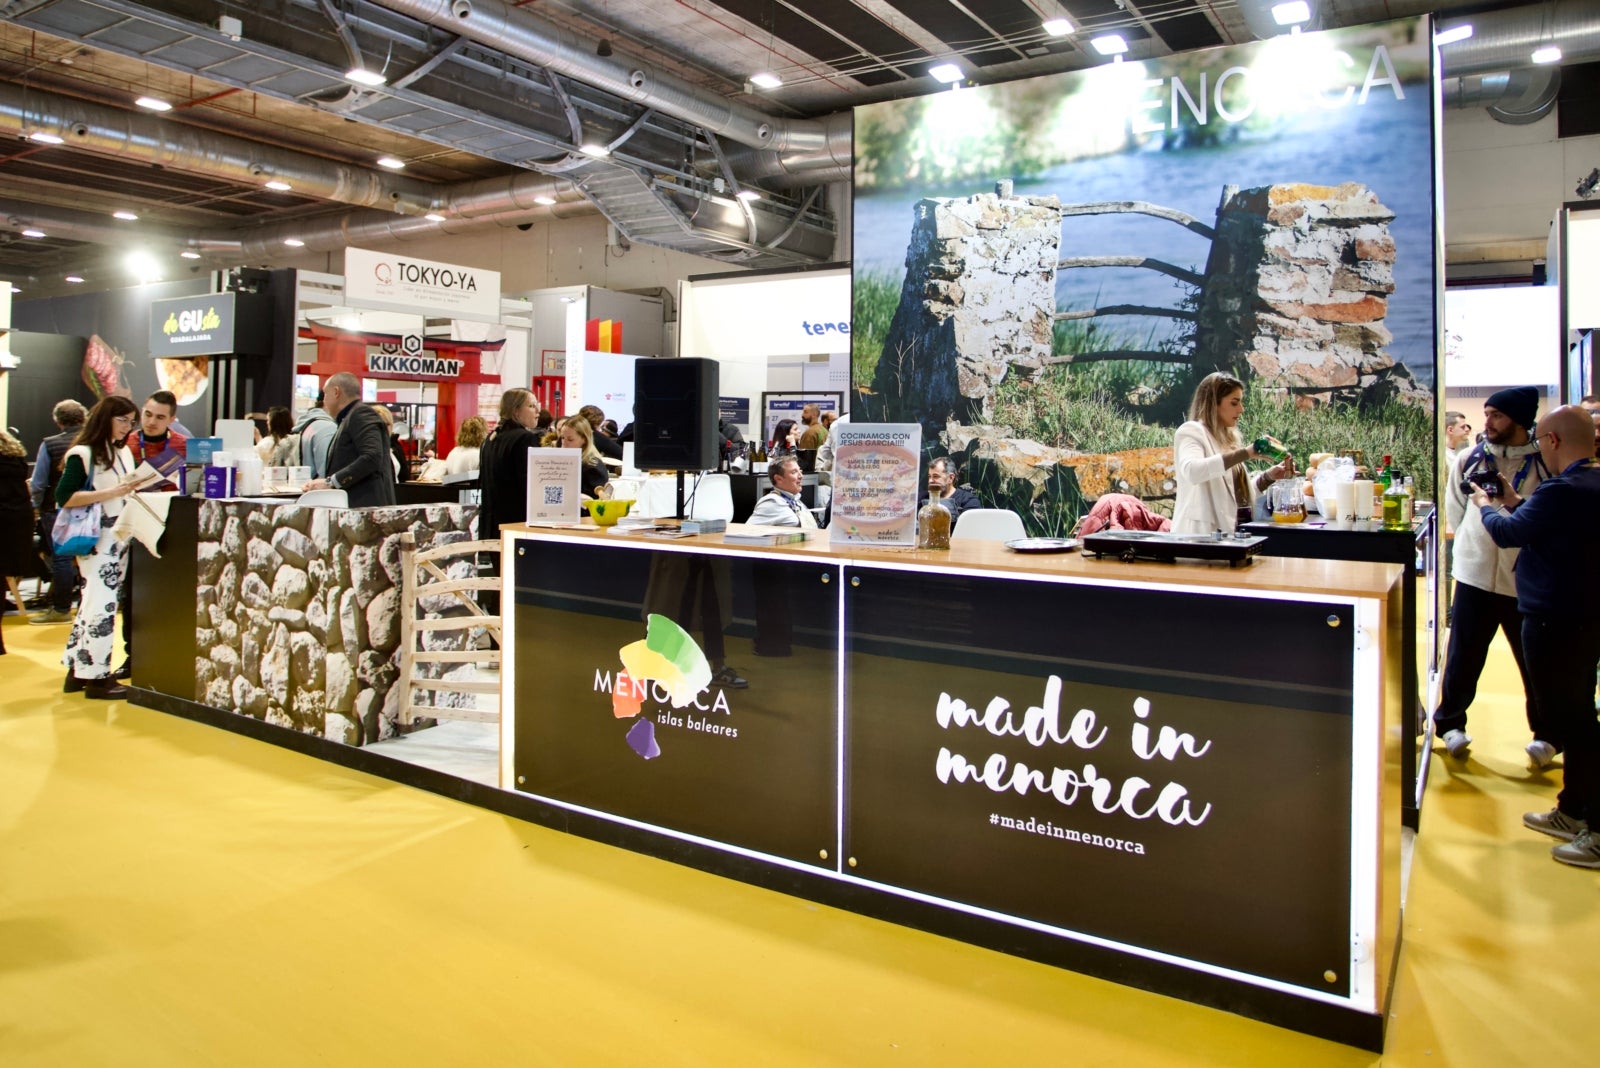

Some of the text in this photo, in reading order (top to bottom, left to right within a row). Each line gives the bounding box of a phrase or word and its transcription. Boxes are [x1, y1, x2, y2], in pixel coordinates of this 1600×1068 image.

[1095, 45, 1405, 137] ENOCA
[398, 262, 477, 291] TOKYO-YA
[802, 320, 850, 336] tene
[370, 355, 460, 375] KIKKOMAN
[593, 668, 731, 715] MENOCA
[657, 710, 738, 738] islas baleares
[936, 674, 1212, 761] made in
[936, 747, 1212, 826] menorca
[989, 812, 1146, 855] #madeinmenorca
